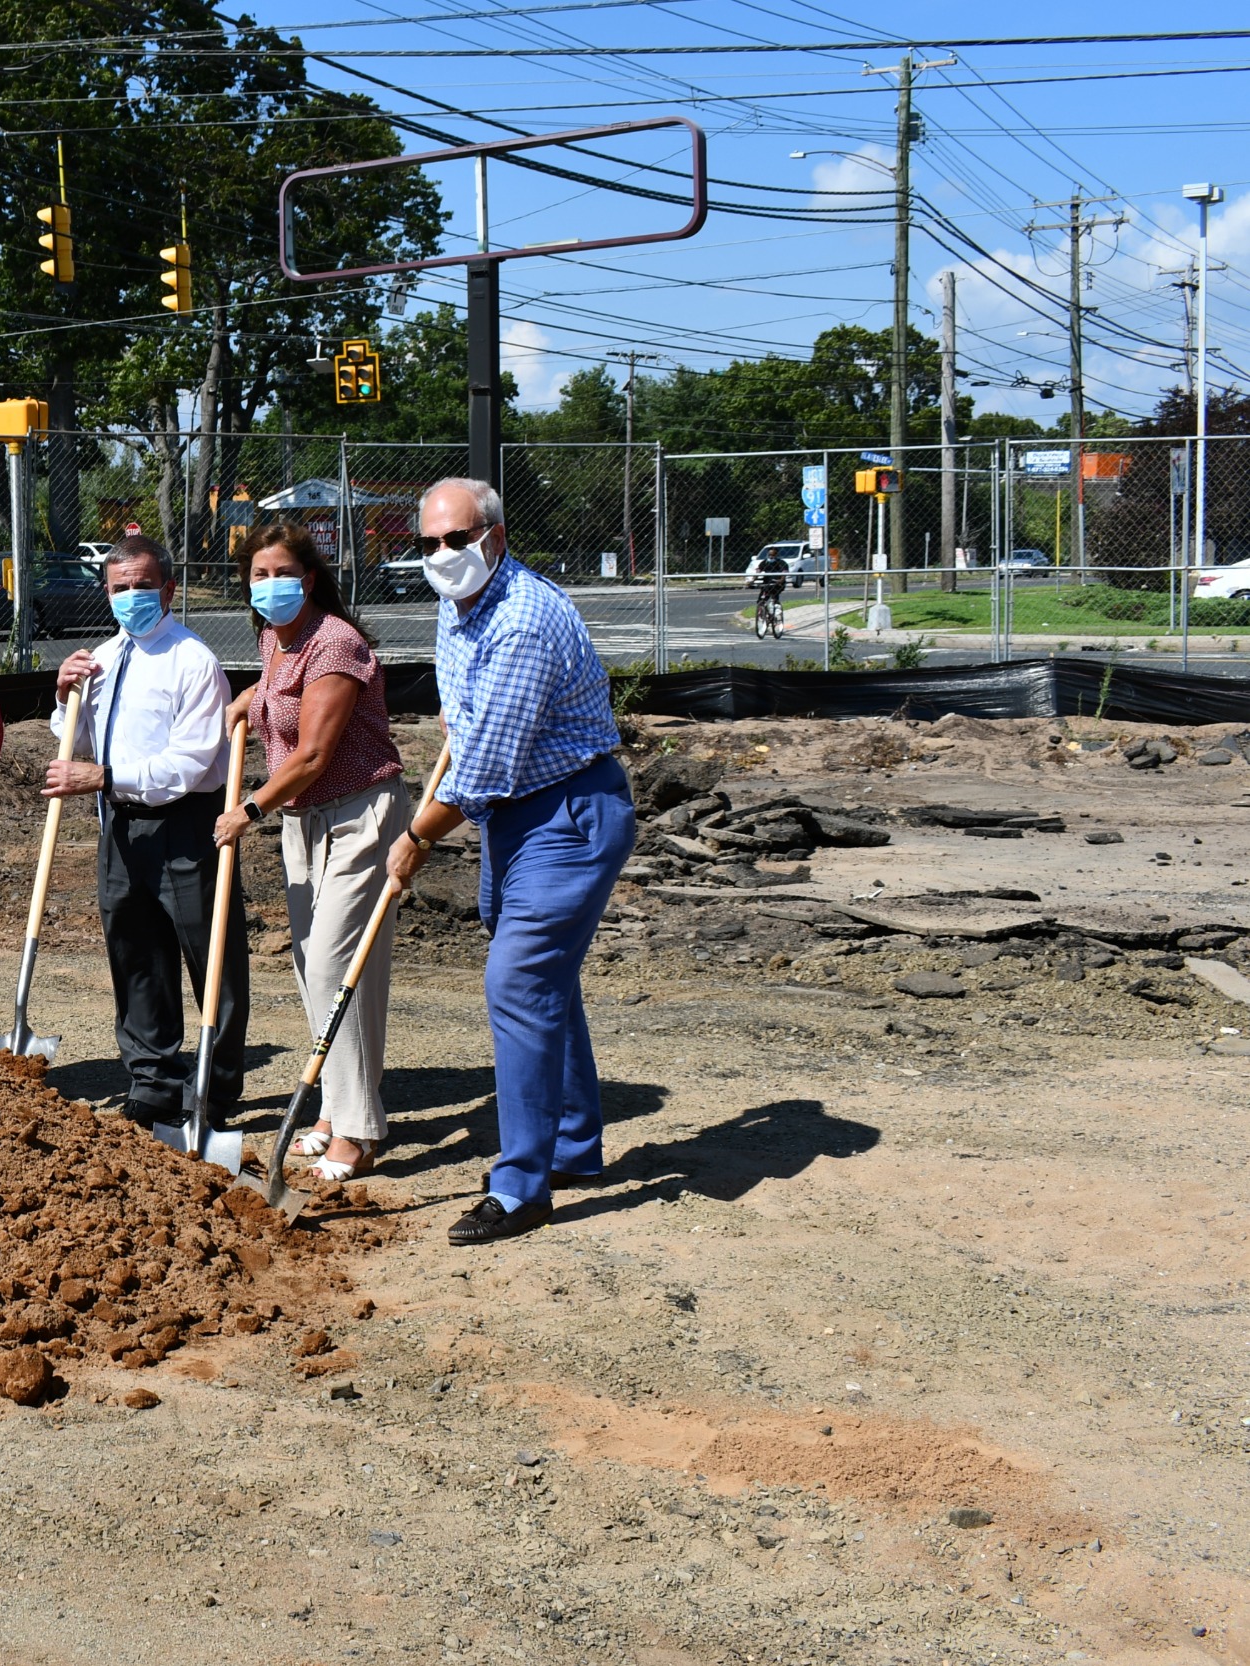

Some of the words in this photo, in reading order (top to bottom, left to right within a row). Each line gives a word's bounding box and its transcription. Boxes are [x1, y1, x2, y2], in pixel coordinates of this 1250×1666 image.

[308, 492, 321, 501] 165
[806, 490, 821, 504] 91
[307, 521, 334, 533] TOWN
